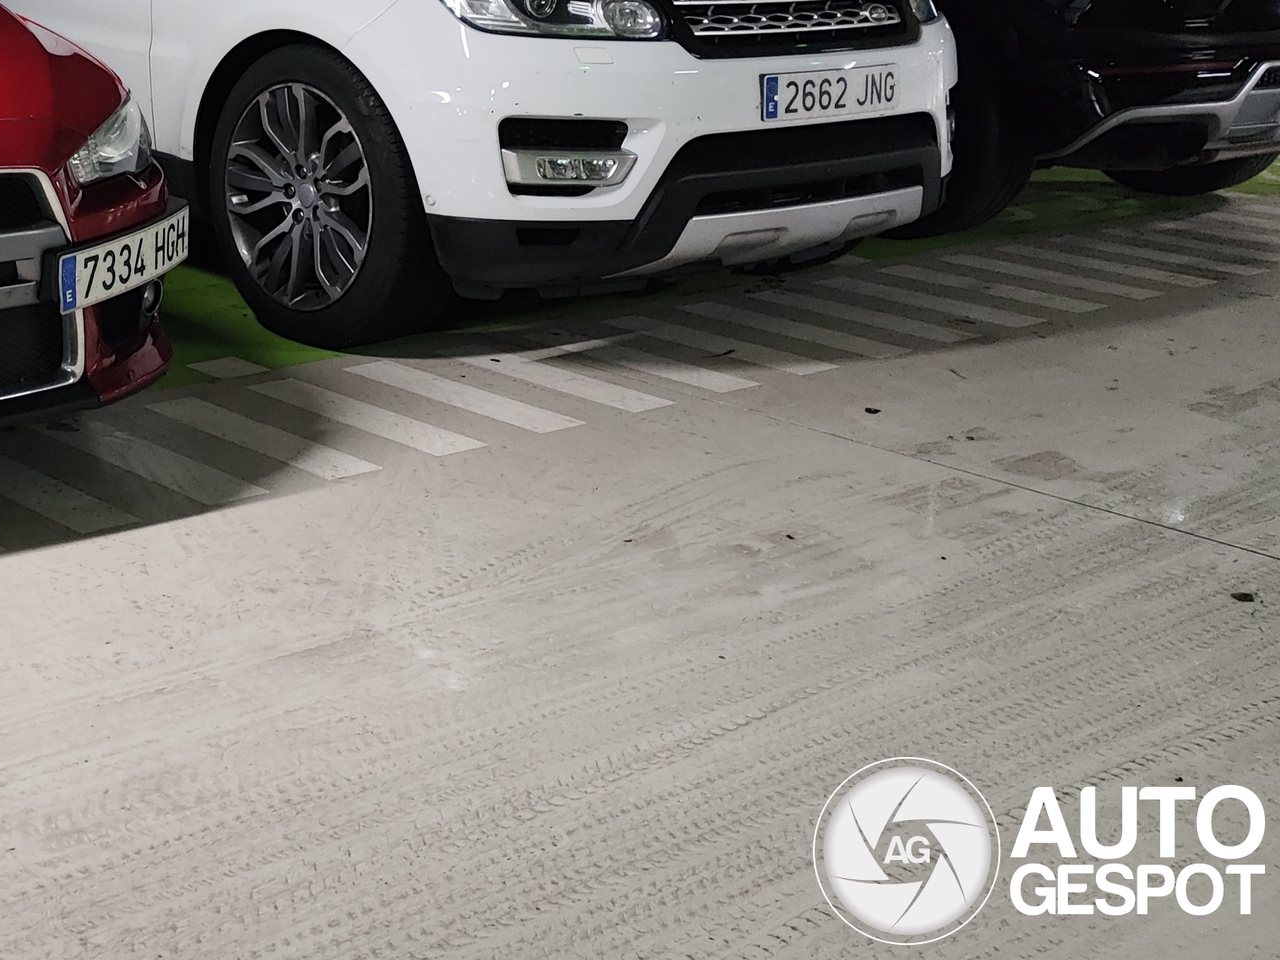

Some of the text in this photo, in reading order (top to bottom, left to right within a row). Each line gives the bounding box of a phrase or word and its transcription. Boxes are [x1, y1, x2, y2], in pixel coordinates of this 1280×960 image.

[784, 71, 895, 114] 2662 JNG
[768, 102, 775, 112] E
[83, 215, 186, 299] 7334 HGH
[66, 289, 73, 303] E
